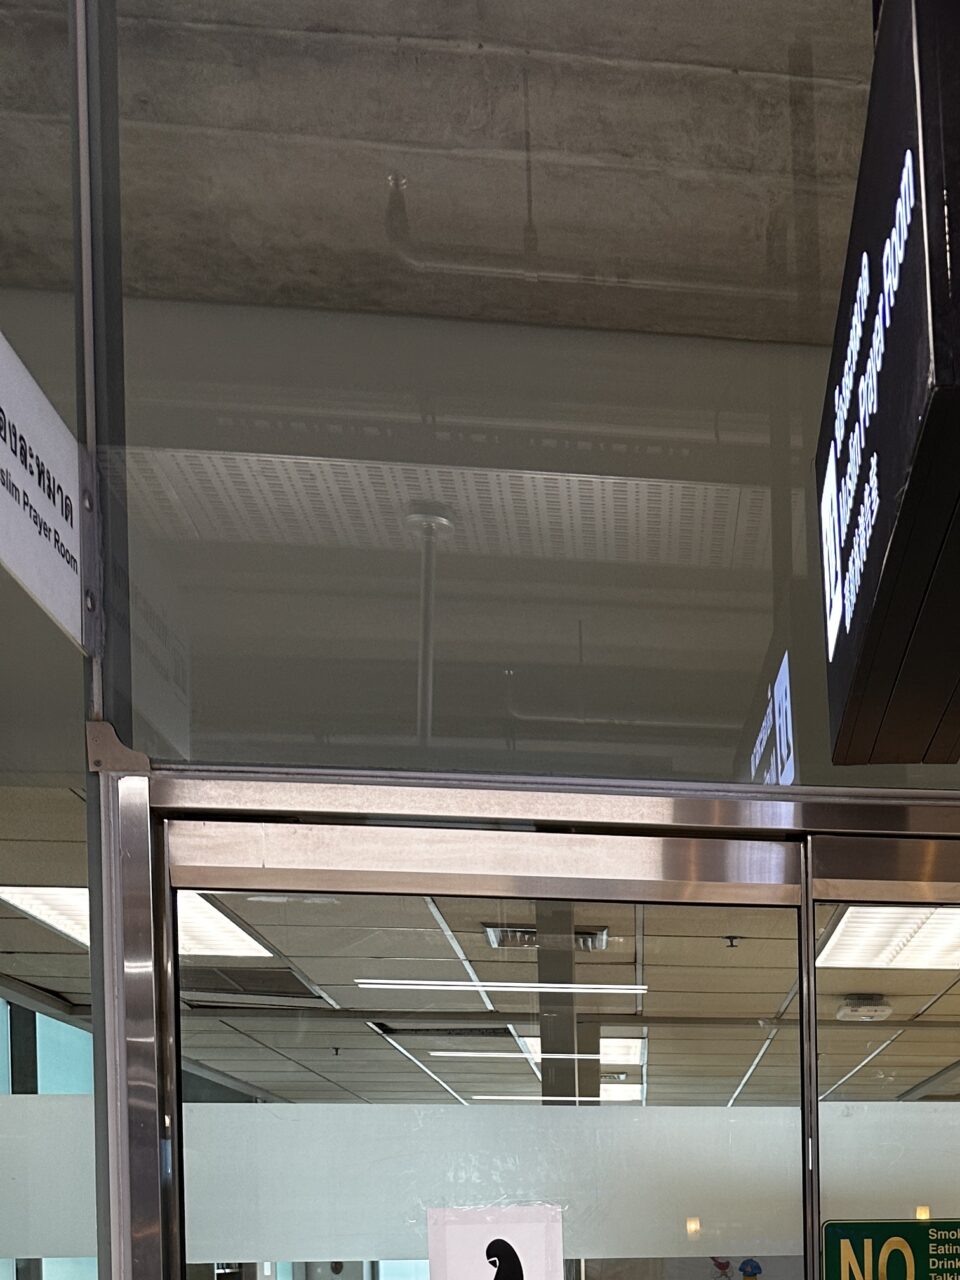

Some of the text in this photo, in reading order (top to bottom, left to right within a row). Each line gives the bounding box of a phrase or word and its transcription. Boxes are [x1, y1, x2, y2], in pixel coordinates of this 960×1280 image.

[838, 148, 915, 548] Muslim Prayer Room
[22, 488, 52, 543] Prayer
[53, 528, 79, 575] Room
